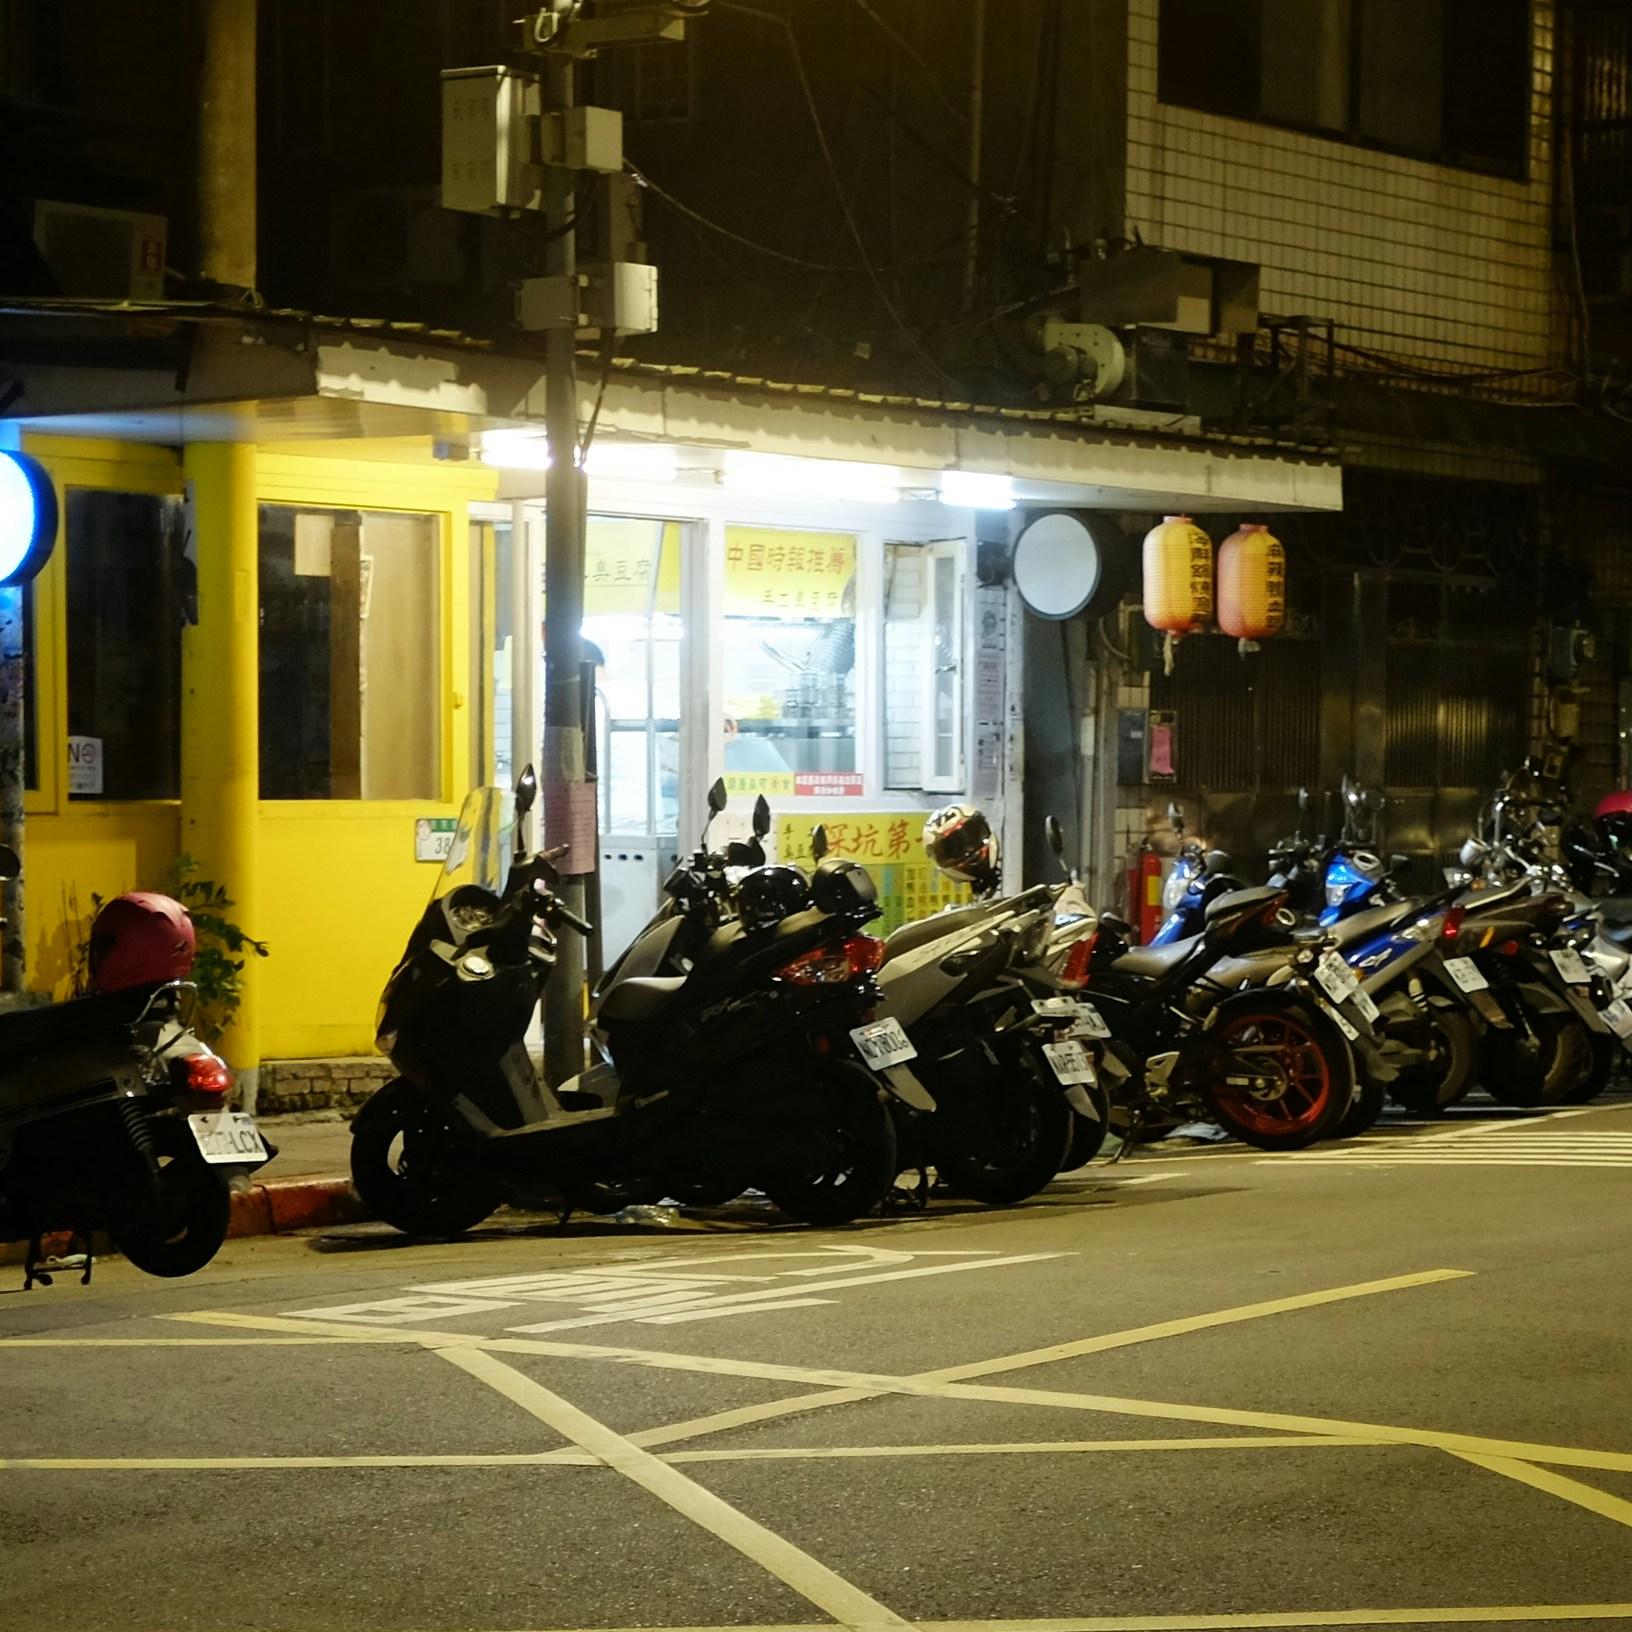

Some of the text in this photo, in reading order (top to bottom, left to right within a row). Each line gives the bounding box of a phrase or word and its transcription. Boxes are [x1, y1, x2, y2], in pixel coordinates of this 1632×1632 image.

[727, 542, 847, 576] 中國時報推薦
